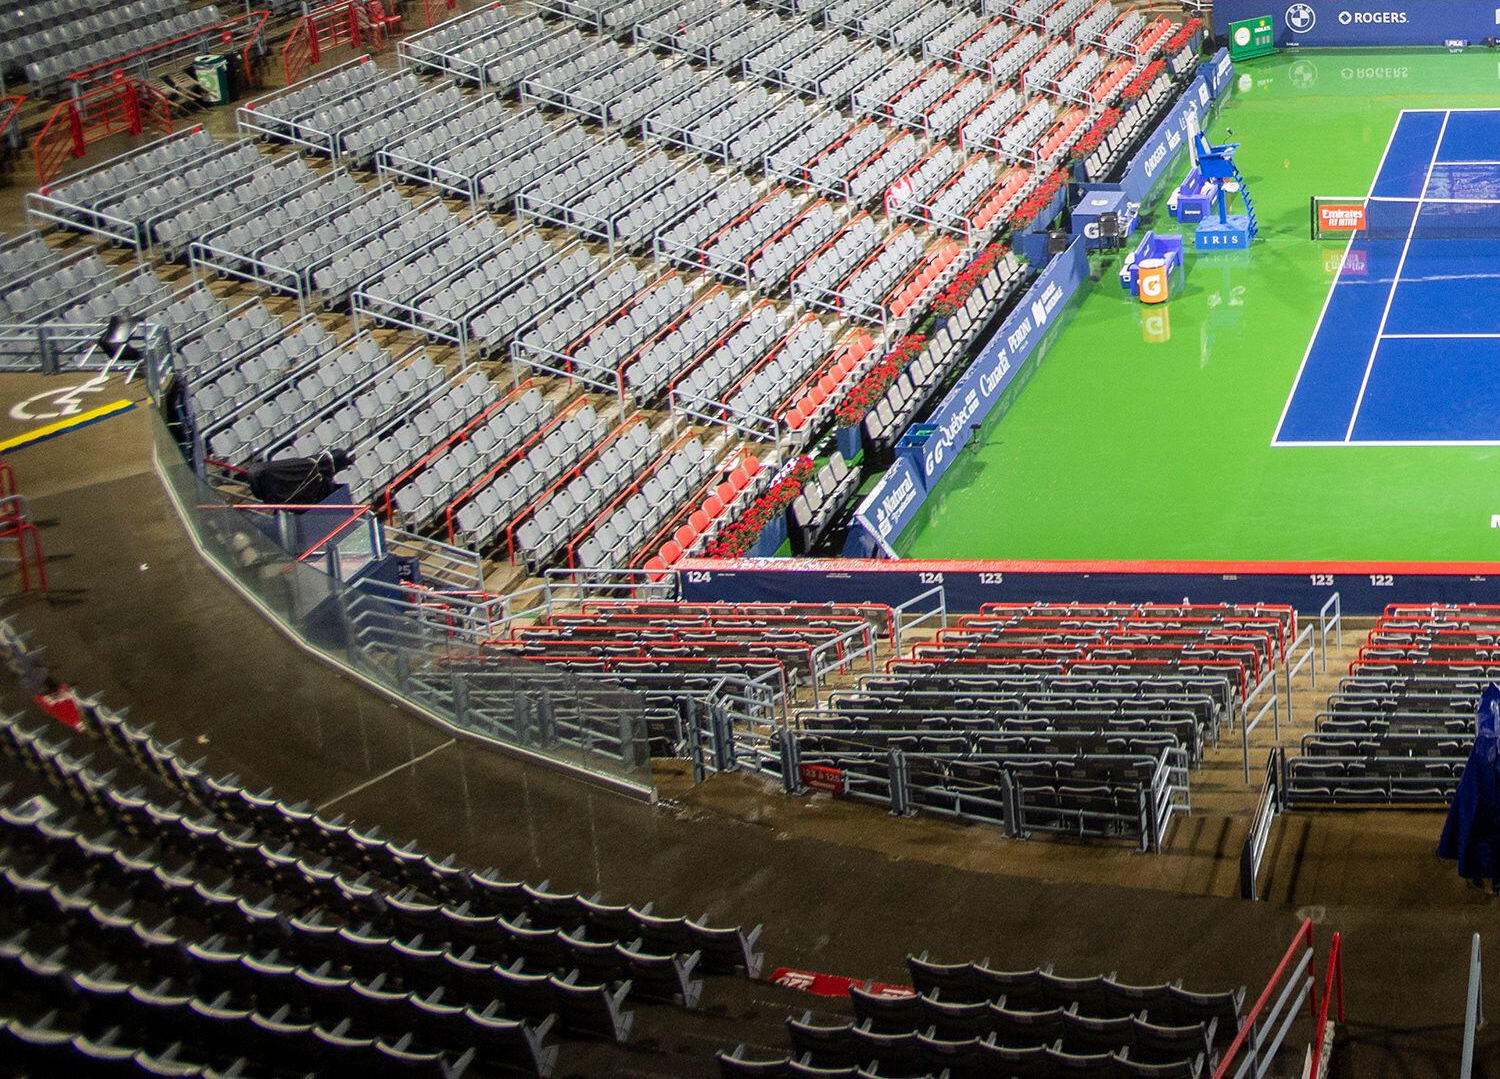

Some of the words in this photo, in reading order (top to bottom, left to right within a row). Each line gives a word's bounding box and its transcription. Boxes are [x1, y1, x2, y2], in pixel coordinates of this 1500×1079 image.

[1354, 12, 1407, 24] ROGERS
[1322, 209, 1363, 219] Emirates
[1203, 235, 1238, 244] IRIS
[1142, 275, 1161, 296] G
[1007, 317, 1032, 354] PERONI
[980, 356, 1011, 397] Canada
[940, 404, 971, 448] Québec
[882, 472, 914, 516] Natural
[687, 571, 712, 583] 124
[919, 572, 944, 584] 124
[978, 573, 1003, 584] 123
[1310, 575, 1334, 586] 123
[1370, 575, 1394, 586] 122
